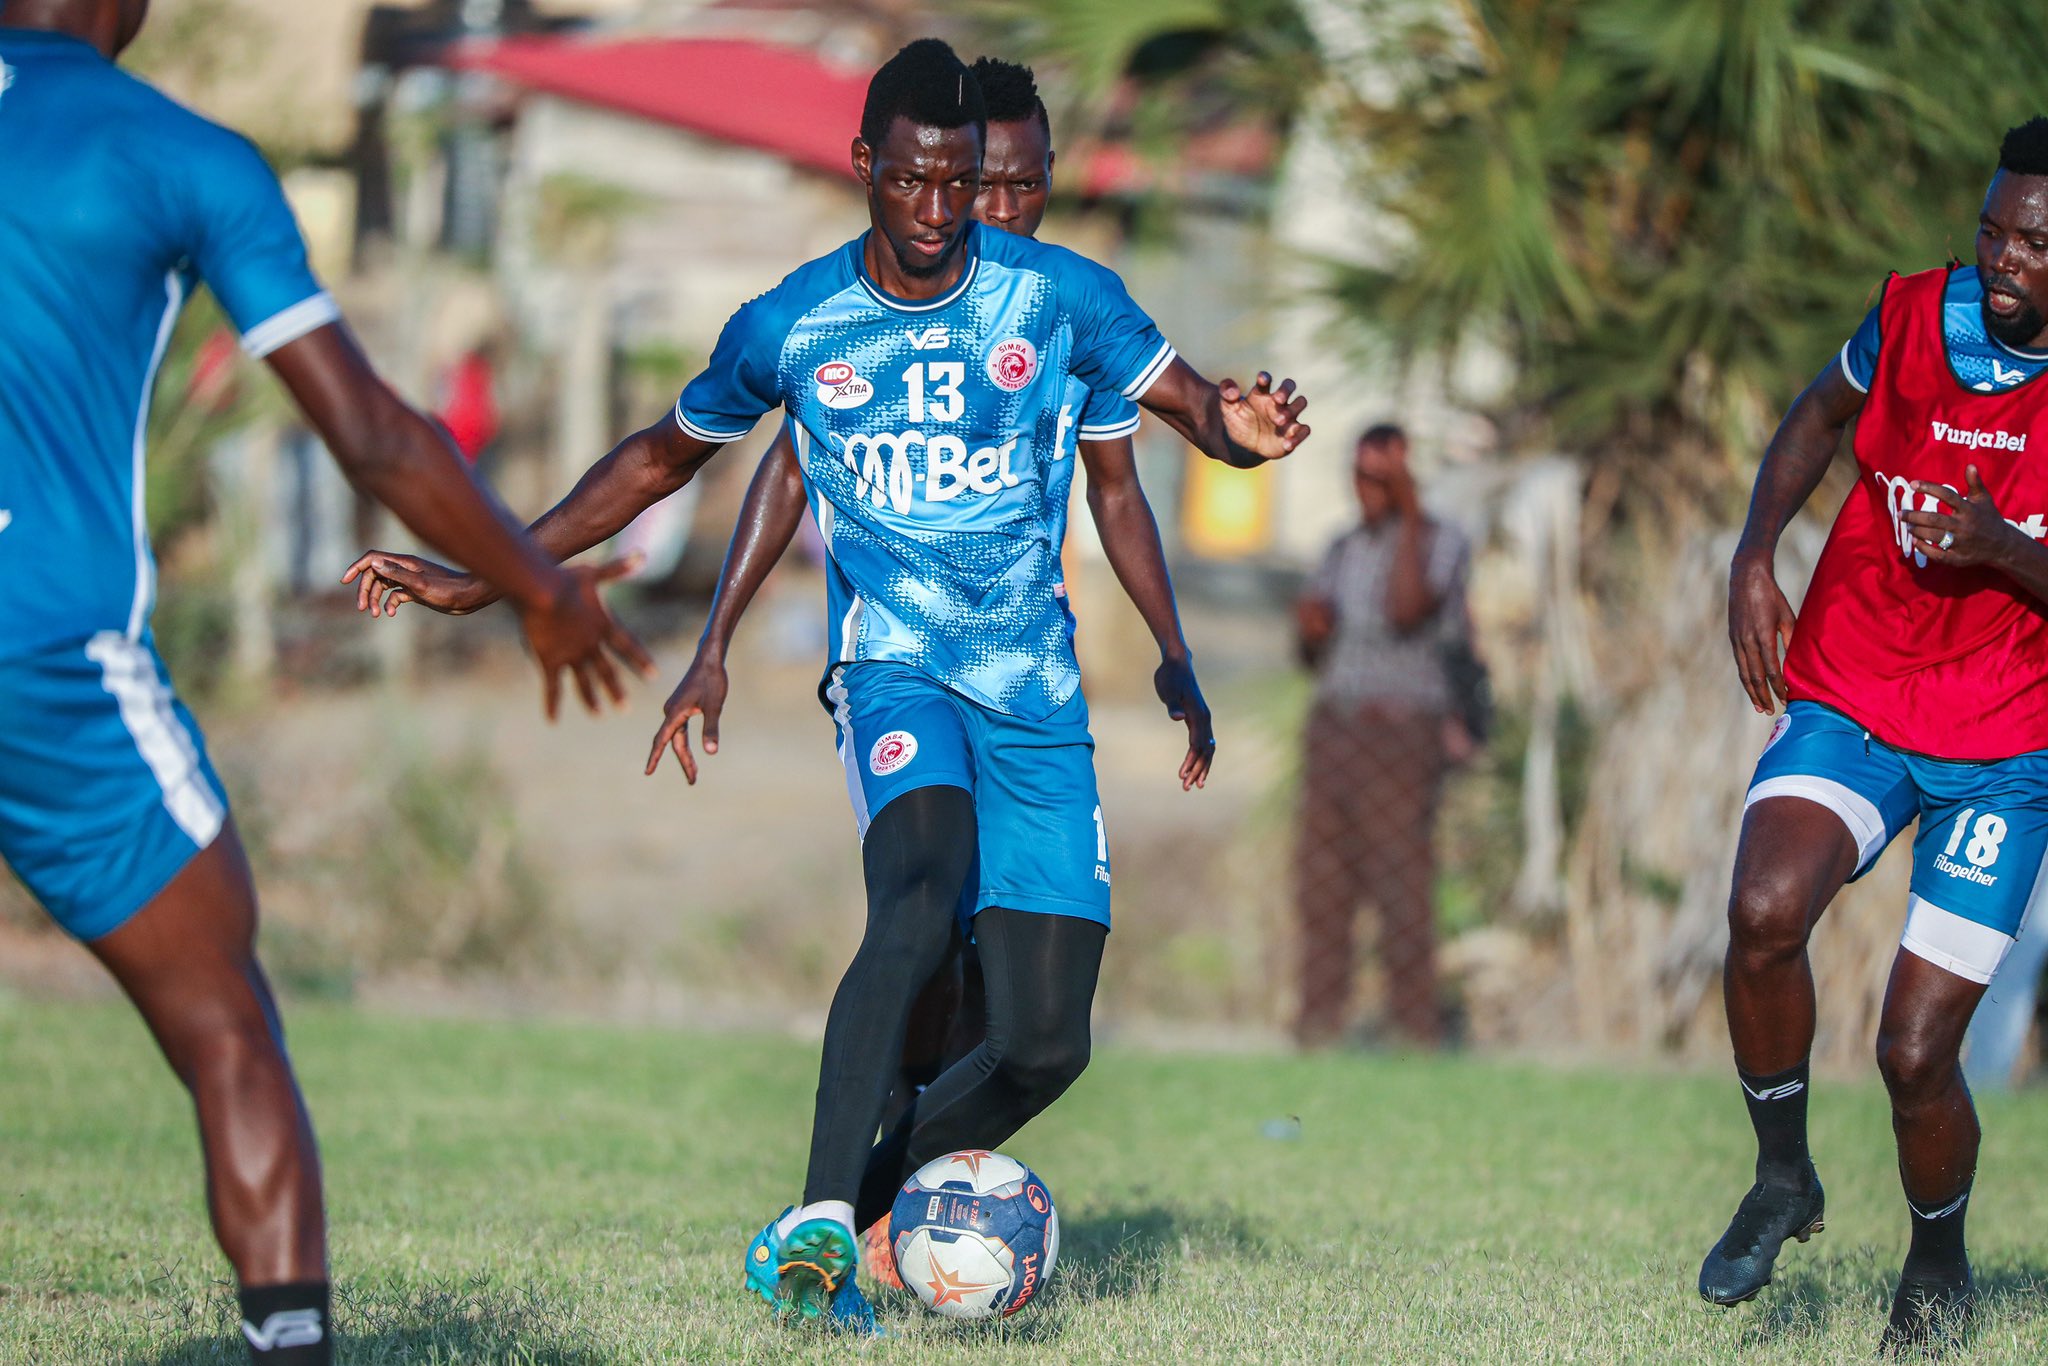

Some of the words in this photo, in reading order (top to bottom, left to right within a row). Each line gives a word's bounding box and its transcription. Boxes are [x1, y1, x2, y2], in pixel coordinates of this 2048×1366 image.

[998, 343, 1026, 354] SIMBA
[902, 362, 965, 423] 13
[877, 734, 903, 747] SIMBA
[1944, 808, 2008, 868] 18
